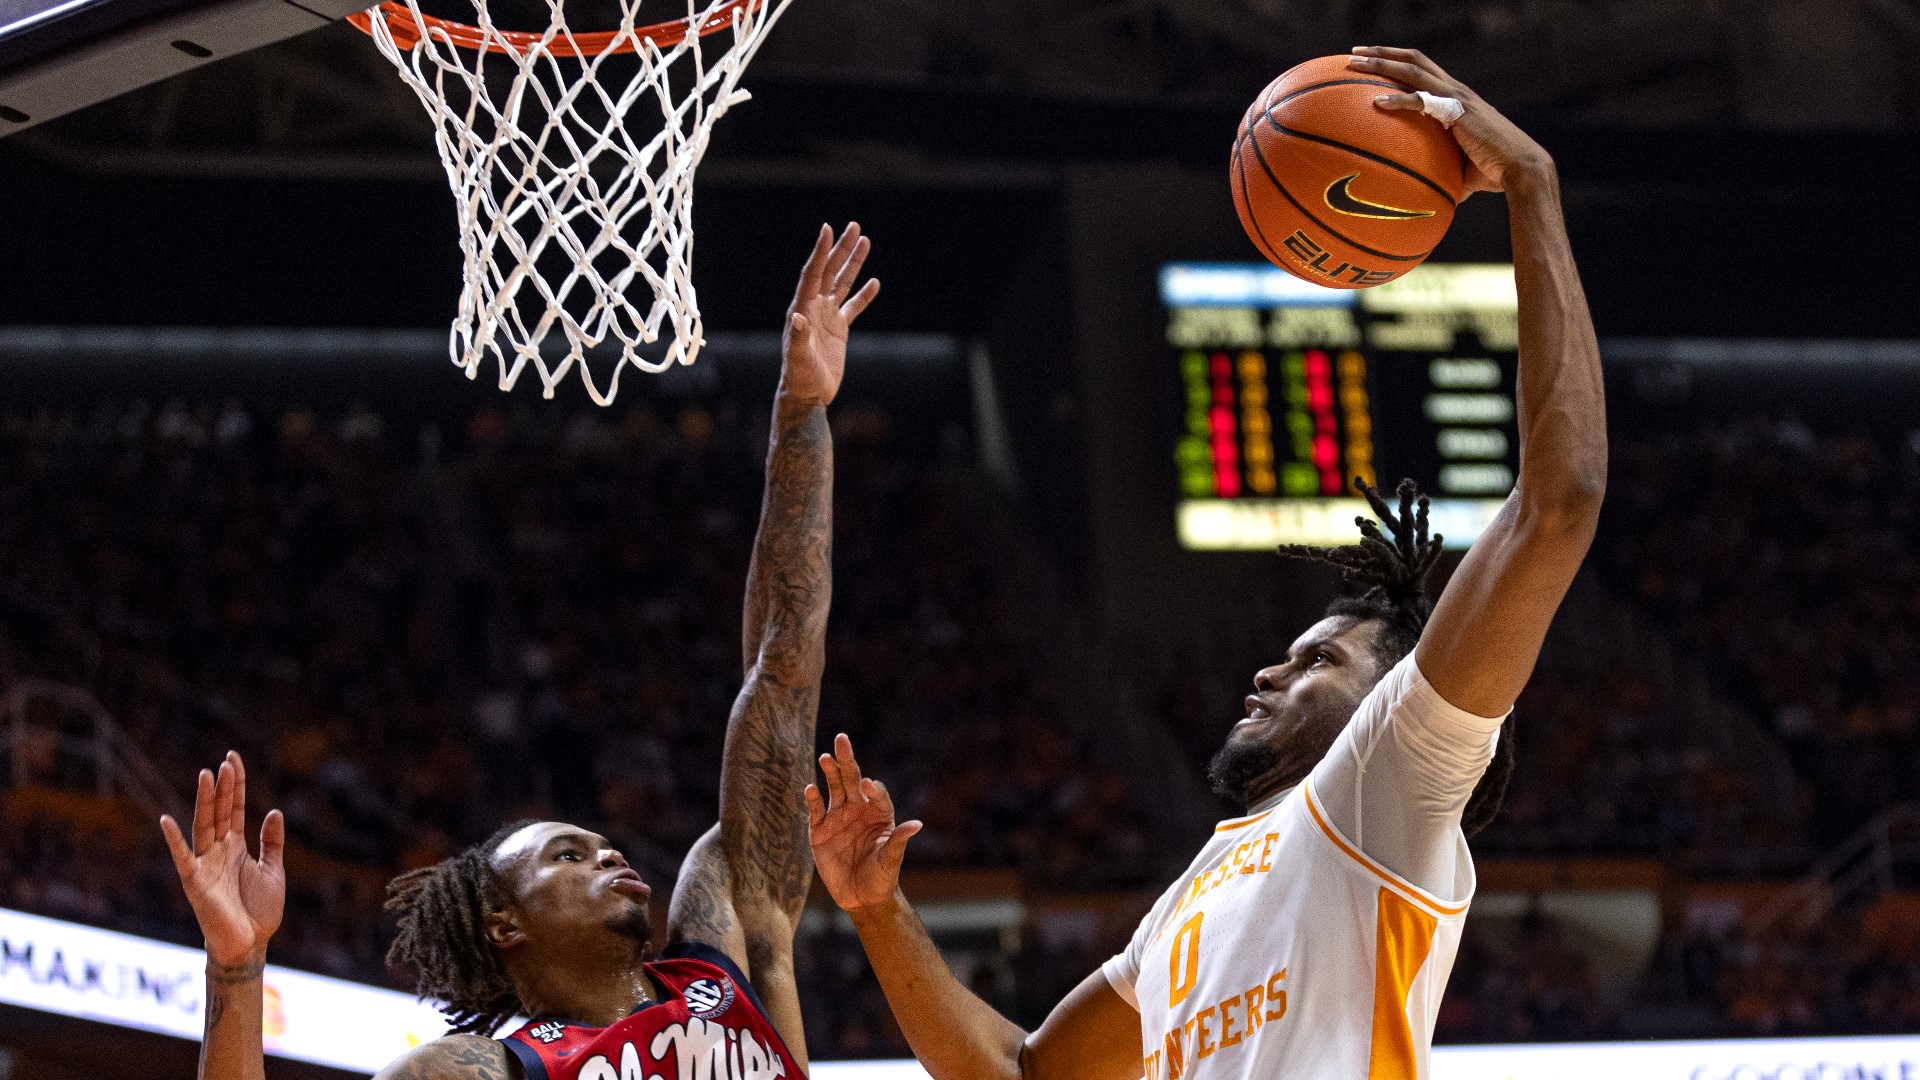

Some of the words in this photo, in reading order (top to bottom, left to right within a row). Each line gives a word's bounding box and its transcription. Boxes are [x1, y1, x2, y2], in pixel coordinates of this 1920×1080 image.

[1283, 229, 1396, 285] ELITE
[0, 935, 201, 1016] MAKING
[1169, 911, 1205, 1006] 0
[530, 1021, 566, 1037] BALL
[540, 1029, 564, 1043] 24
